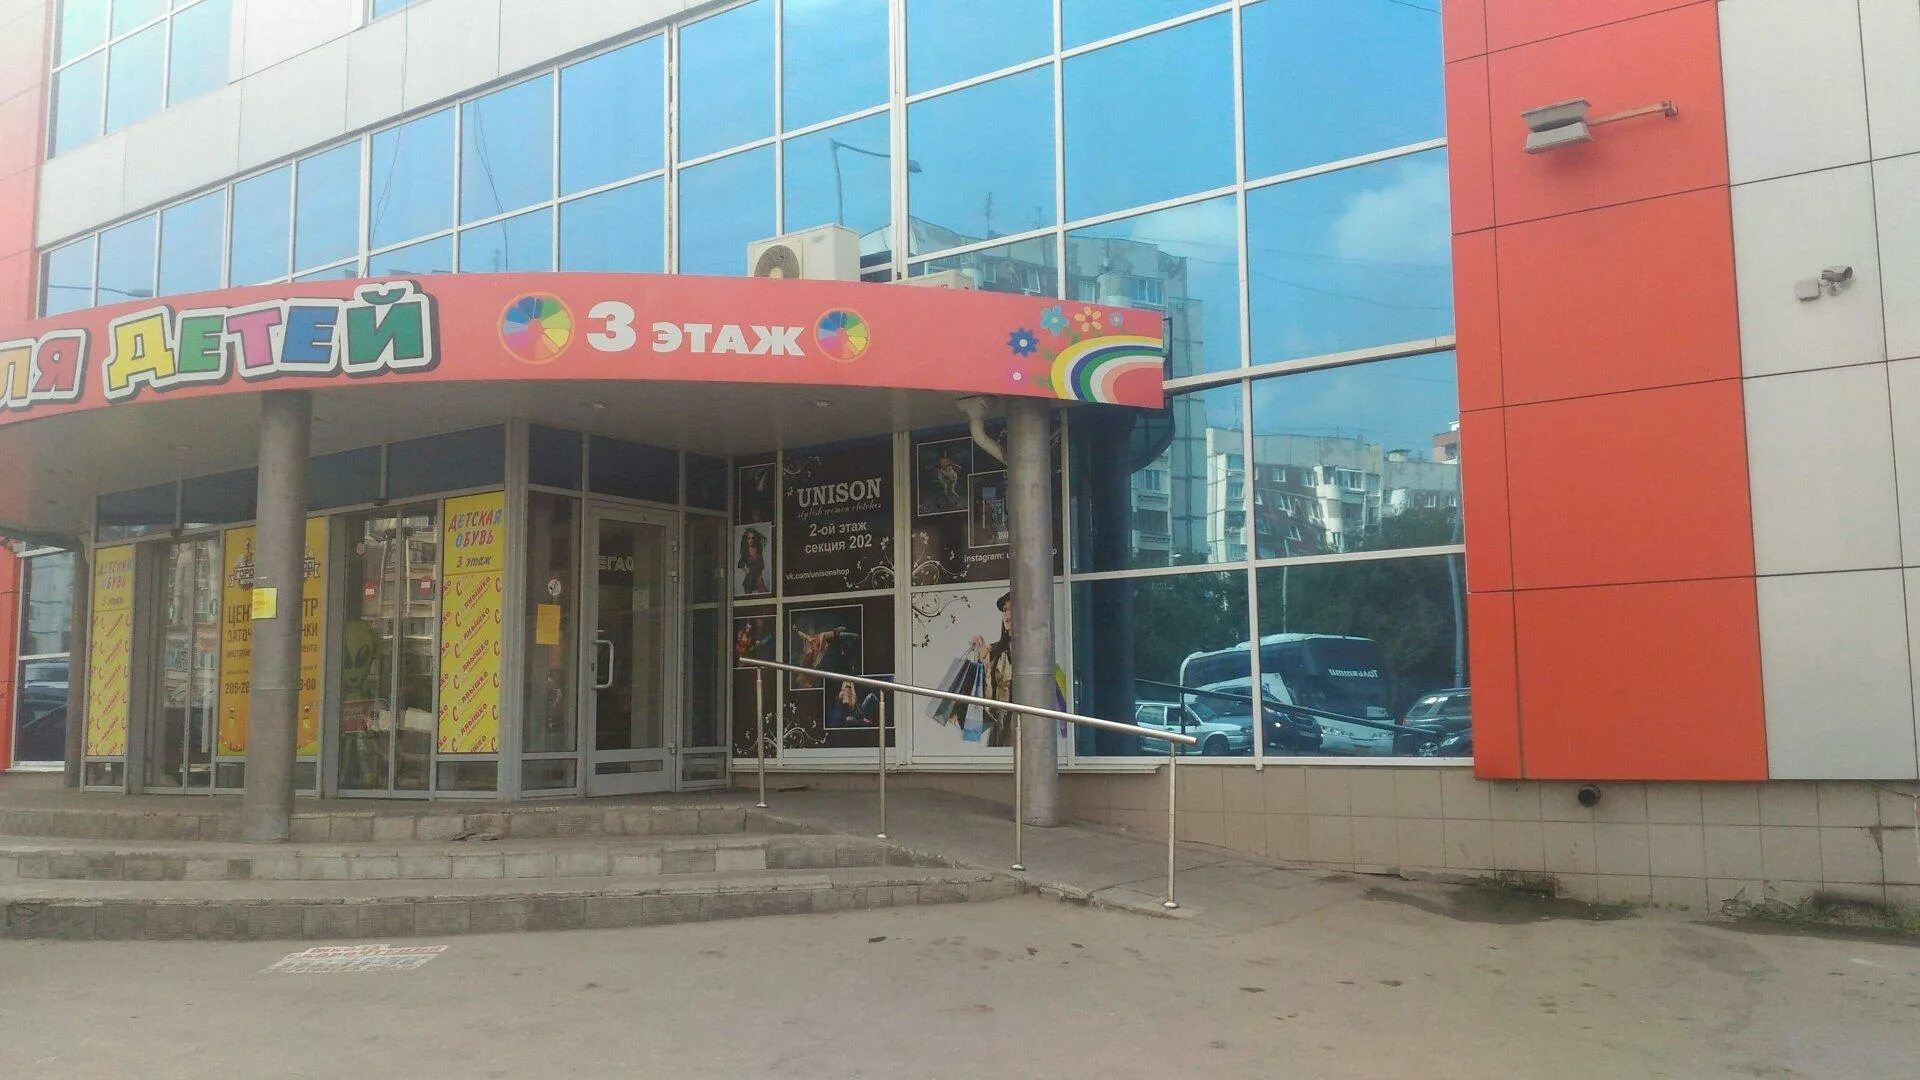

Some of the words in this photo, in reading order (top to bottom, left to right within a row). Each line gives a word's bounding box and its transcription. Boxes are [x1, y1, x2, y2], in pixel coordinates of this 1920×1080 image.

[586, 301, 635, 351] 3
[0, 329, 88, 408] ЛЯ
[103, 281, 433, 399] ДЕТЕЙ
[796, 478, 882, 507] UNISON
[448, 508, 503, 532] ДЕТСКАЯ
[809, 523, 836, 537] 2-ой
[839, 520, 867, 533] этаж
[455, 529, 495, 548] ОБУВЬ
[805, 540, 845, 554] секция
[849, 534, 873, 549] 202
[456, 556, 463, 568] 3
[465, 555, 493, 567] этаж
[785, 568, 850, 580] vk.com/unisonshop
[228, 603, 253, 627] ЦЕН
[225, 681, 250, 694] 205-28
